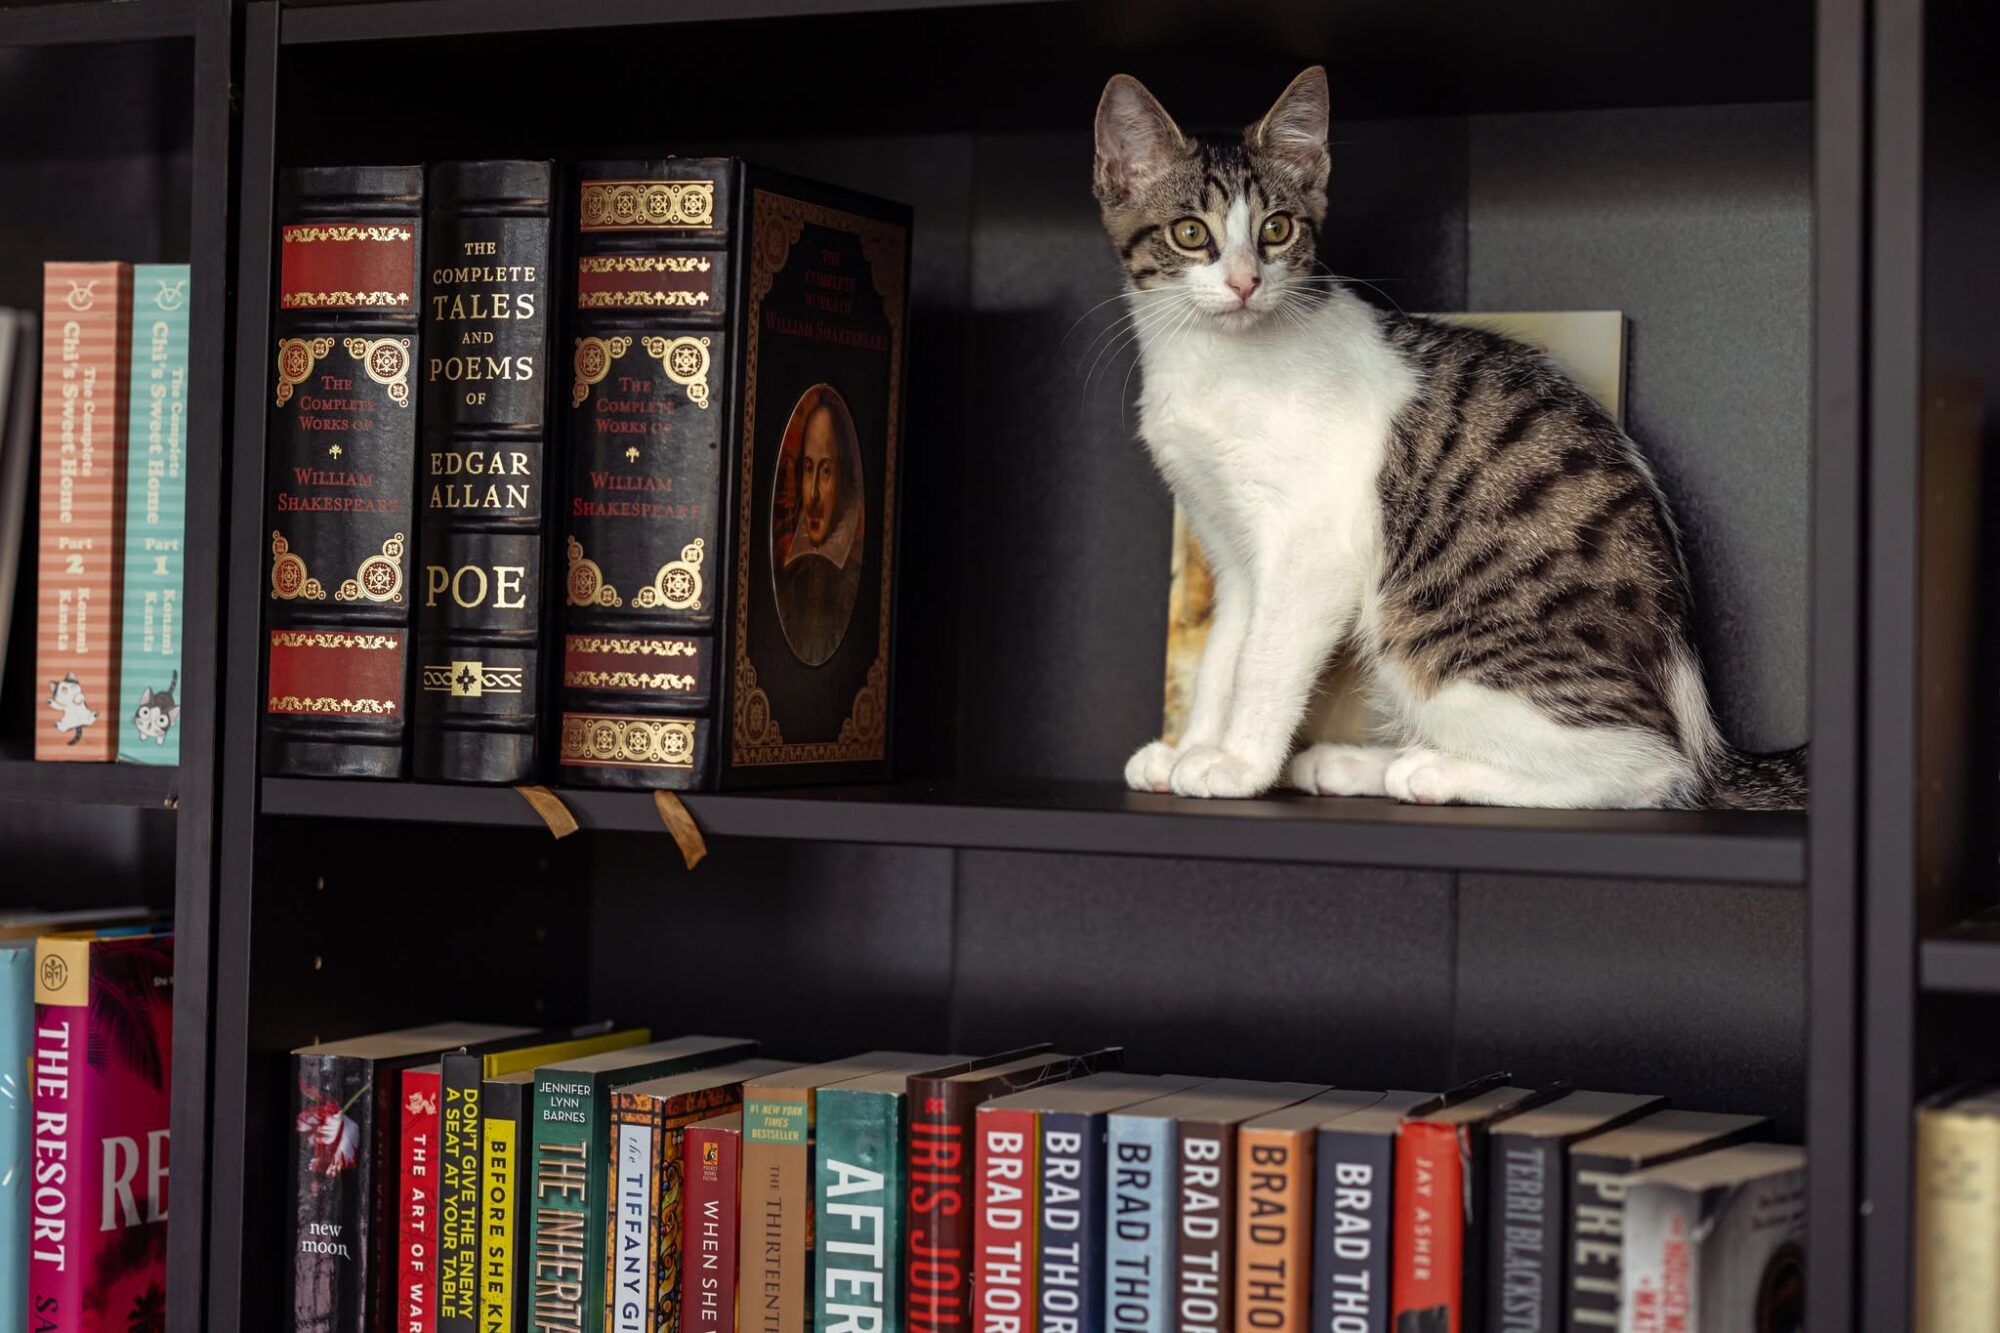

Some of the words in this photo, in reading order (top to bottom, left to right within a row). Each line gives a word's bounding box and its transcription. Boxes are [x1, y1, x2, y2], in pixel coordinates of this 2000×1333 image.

[464, 242, 496, 255] THE
[432, 266, 536, 284] COMPLETE
[433, 293, 534, 320] TALES
[62, 321, 80, 380] Chi's
[152, 321, 169, 380] Chi's
[462, 332, 494, 344] AND
[83, 367, 96, 398] The
[171, 367, 184, 399] The
[430, 356, 533, 382] POEMS
[61, 383, 79, 454] Sweet
[148, 383, 166, 454] Sweet
[466, 392, 486, 405] OF
[80, 401, 95, 478] Complete
[168, 401, 183, 478] Complete
[430, 452, 530, 476] EDGAR
[60, 458, 78, 524] Home
[146, 458, 164, 524] Home
[430, 484, 530, 510] ALLAN
[58, 537, 93, 550] Part
[65, 554, 85, 576] 2
[145, 538, 179, 551] Part
[153, 556, 169, 576] 1
[426, 565, 527, 609] POE
[58, 590, 72, 652] Kanata
[76, 588, 90, 654] Konami
[143, 591, 158, 652] Kanata
[162, 588, 176, 656] Konami
[36, 1022, 70, 1100] THE
[446, 1087, 461, 1102] A
[539, 1082, 591, 1096] JENNIFER
[550, 1097, 580, 1108] LYNN
[762, 1104, 780, 1115] NEW
[782, 1106, 803, 1116] YORK
[445, 1108, 460, 1158] SEAT
[462, 1088, 478, 1150] DON'T
[543, 1110, 586, 1124] BARNES
[752, 1128, 800, 1140] BESTSELLER
[764, 1117, 789, 1128] TIMES
[412, 1134, 427, 1176] THE
[444, 1164, 460, 1189] AT
[461, 1155, 478, 1202] GIVE
[537, 1138, 586, 1203] THE
[770, 1164, 780, 1192] THE
[910, 1122, 962, 1216] IRIS
[1416, 1157, 1434, 1196] JAY
[33, 1110, 68, 1272] RESORT
[489, 1139, 507, 1238] BEFORE
[986, 1131, 1024, 1230] BRAD
[1044, 1131, 1082, 1232] BRAD
[1116, 1142, 1151, 1242] BRAD
[1182, 1138, 1221, 1240] BRAD
[1249, 1145, 1288, 1246] BRAD
[1504, 1148, 1545, 1222] TERRI
[309, 1222, 342, 1237] new
[411, 1188, 426, 1232] ART
[443, 1196, 458, 1250] YOUR
[460, 1207, 477, 1245] THE
[623, 1174, 644, 1295] TIFFANY
[702, 1200, 720, 1270] WHEN
[1333, 1162, 1372, 1261] BRAD
[302, 1240, 352, 1260] moon
[410, 1244, 424, 1272] OF
[825, 1158, 885, 1333] AFTER
[1413, 1207, 1432, 1280] ASHER
[442, 1256, 458, 1318] TABLE
[458, 1250, 475, 1320] ENEMY
[488, 1246, 504, 1294] SHE
[984, 1241, 1022, 1333] THOR
[1043, 1242, 1080, 1333] THOR
[701, 1278, 718, 1321] SHE
